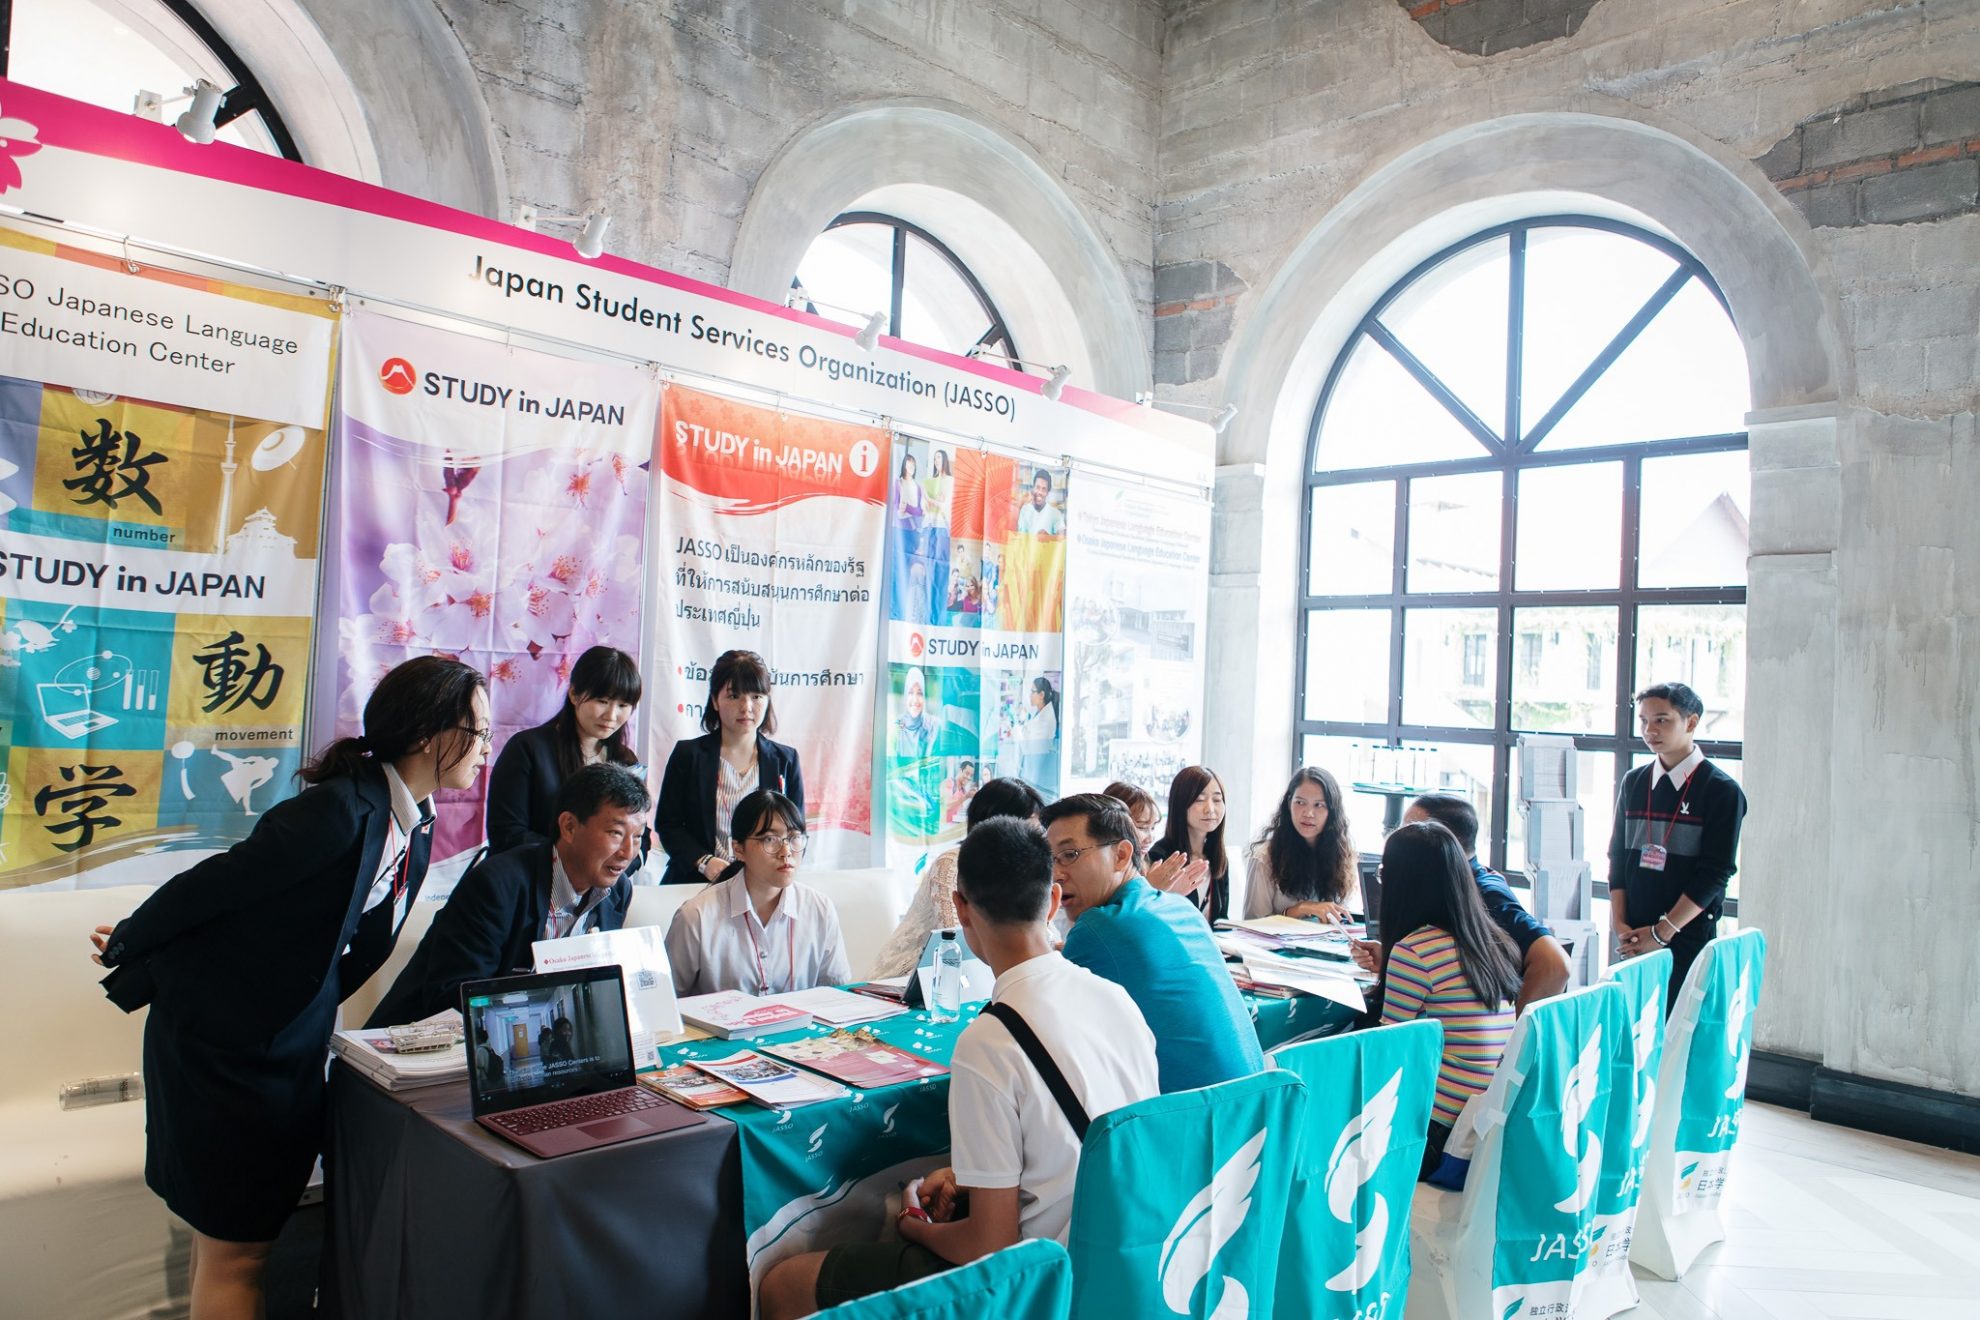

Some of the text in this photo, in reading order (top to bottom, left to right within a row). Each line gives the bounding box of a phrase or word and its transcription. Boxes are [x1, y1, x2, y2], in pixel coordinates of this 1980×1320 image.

[48, 287, 174, 330] Japanese
[186, 314, 299, 355] Language
[1, 312, 236, 375] Education Center
[468, 255, 1016, 423] Japan Student Services Organization (JASSO)
[424, 372, 625, 426] STUDY in JAPAN
[675, 420, 749, 455] STUDY
[753, 439, 772, 464] in
[774, 448, 843, 475] JAPAN
[62, 418, 168, 517] 数
[112, 526, 176, 544] number
[676, 536, 722, 561] JASSO
[117, 566, 147, 593] in
[156, 571, 266, 600] JAPAN
[928, 639, 1039, 660] STUDY in JAPAN
[193, 631, 284, 716] 動
[215, 728, 293, 742] movement
[34, 764, 137, 853] 学
[548, 1061, 567, 1069] JASSO
[849, 1103, 869, 1113] JASSO
[772, 1123, 794, 1133] JASSO
[805, 1150, 823, 1163] JASSO
